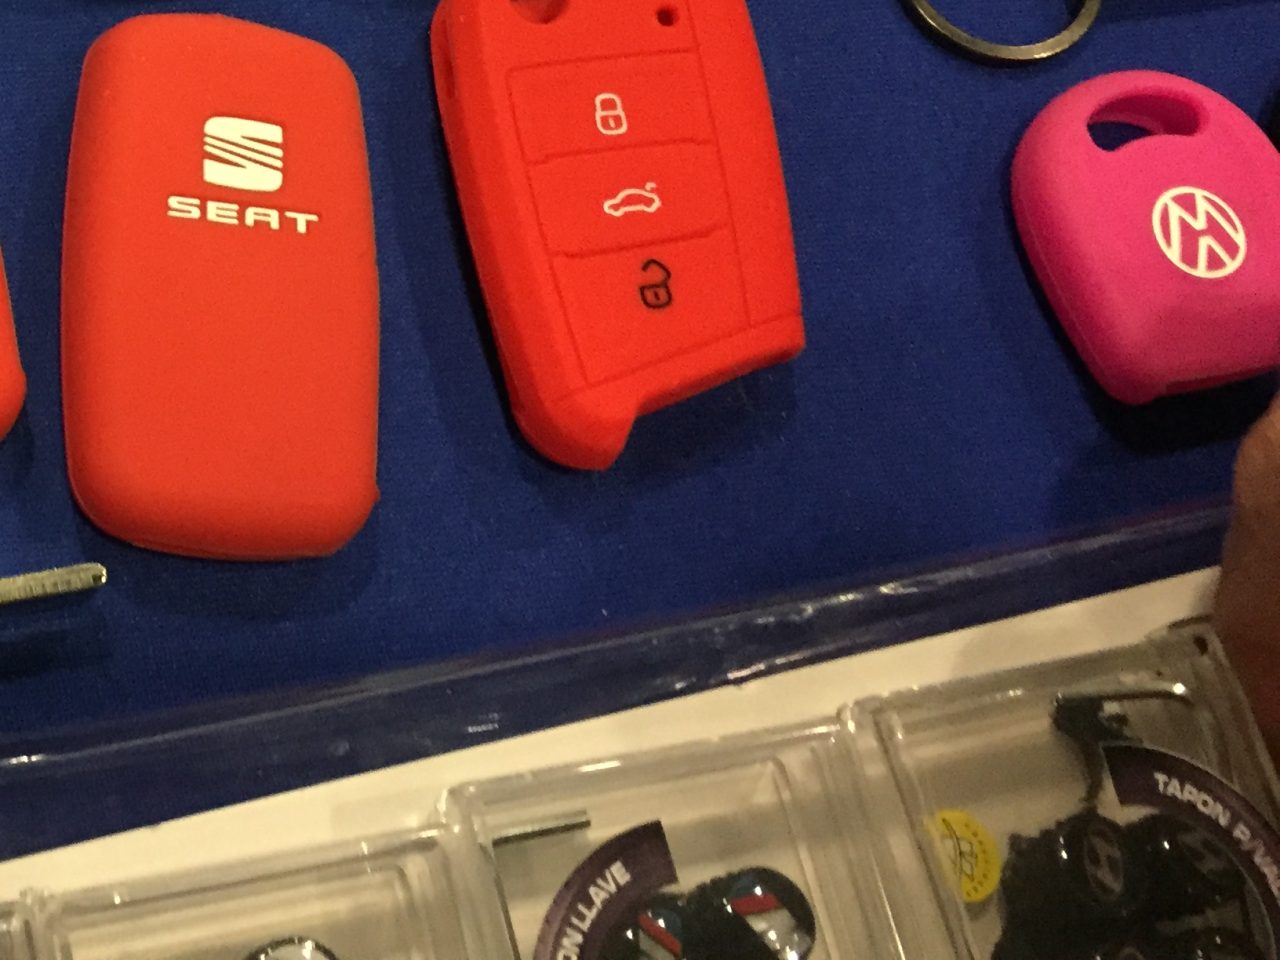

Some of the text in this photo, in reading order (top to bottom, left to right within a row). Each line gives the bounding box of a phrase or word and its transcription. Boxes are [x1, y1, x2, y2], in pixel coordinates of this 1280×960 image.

[167, 195, 319, 235] SEAT
[1153, 772, 1231, 827] TAPON
[571, 860, 632, 933] LLAVE
